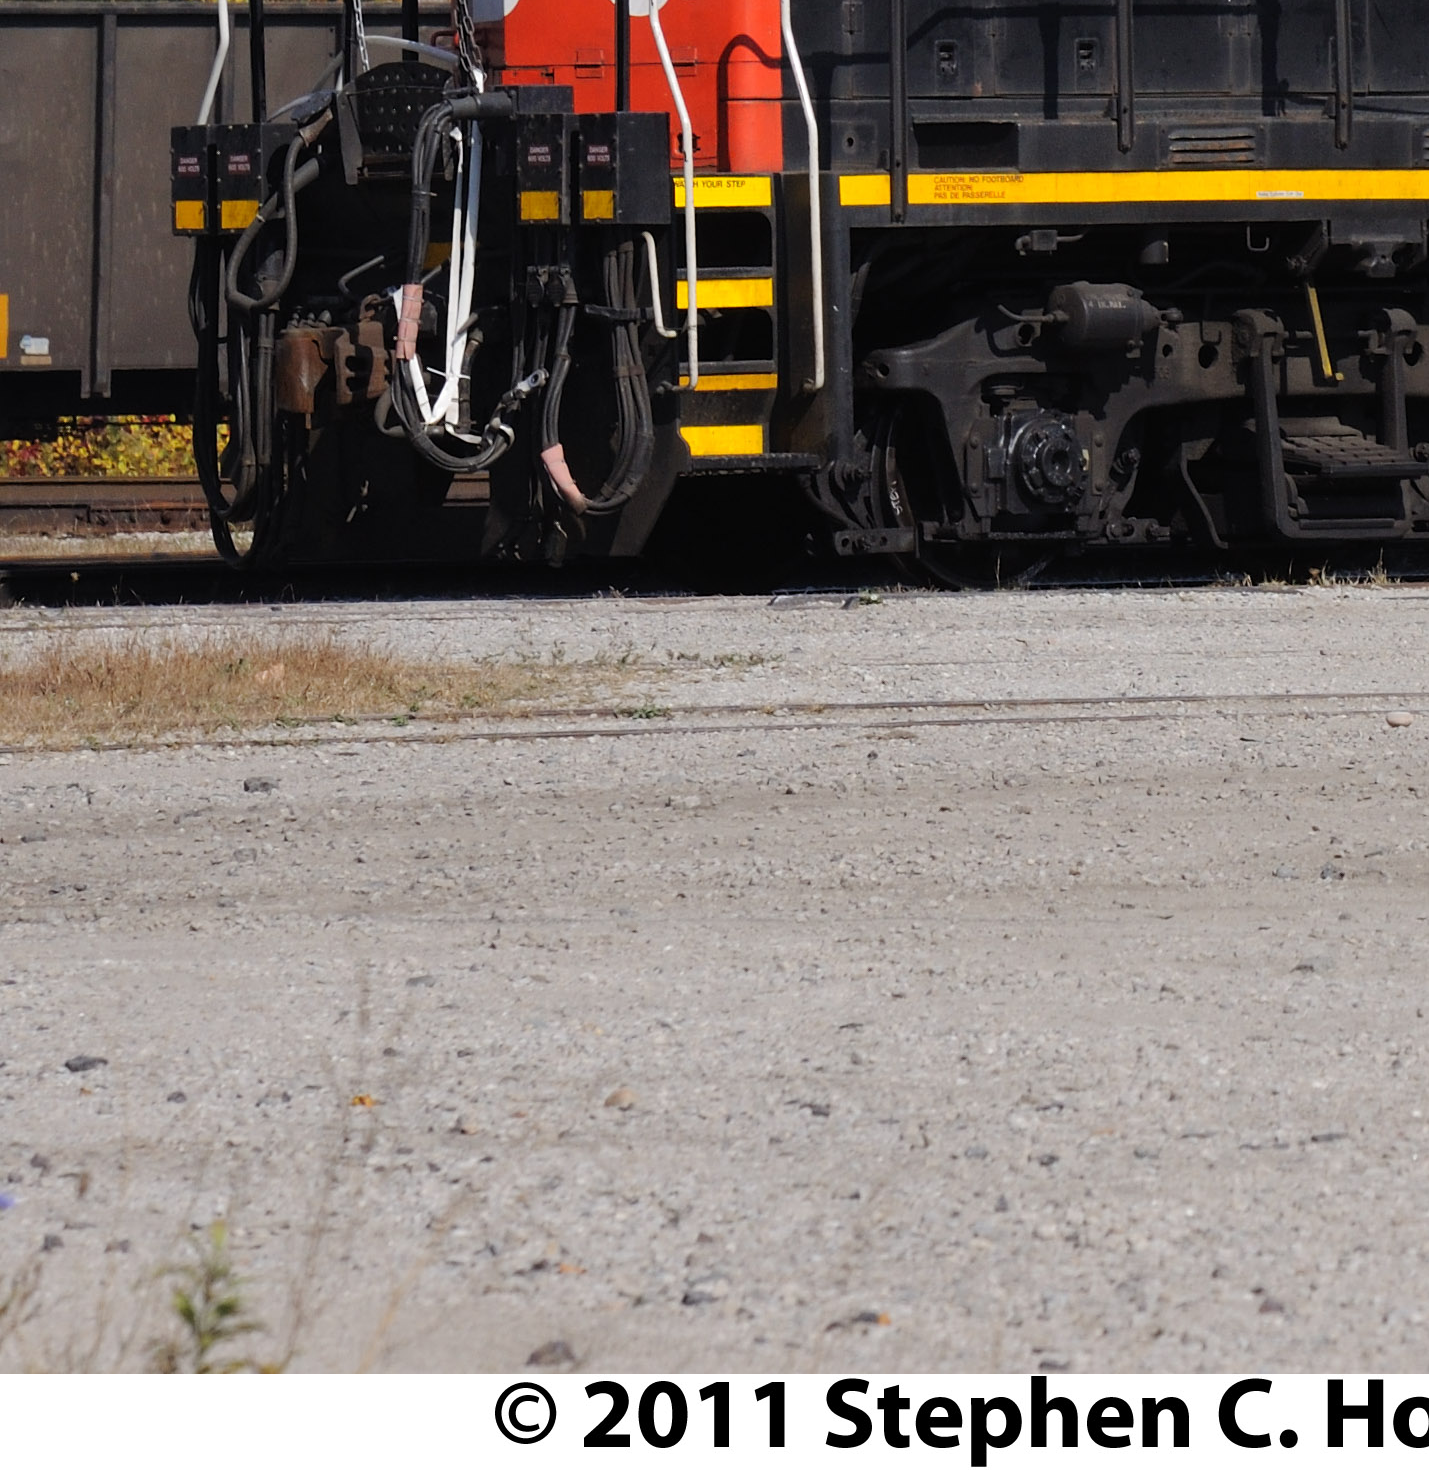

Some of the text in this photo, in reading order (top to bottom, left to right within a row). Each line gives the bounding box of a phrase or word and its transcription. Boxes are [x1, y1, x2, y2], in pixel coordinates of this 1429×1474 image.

[969, 175, 980, 183] NO
[982, 175, 1024, 183] FOOTBOARD
[674, 179, 746, 188] WAH YOUR STEP
[950, 191, 959, 199] DE
[962, 191, 1006, 199] PASSERELLE
